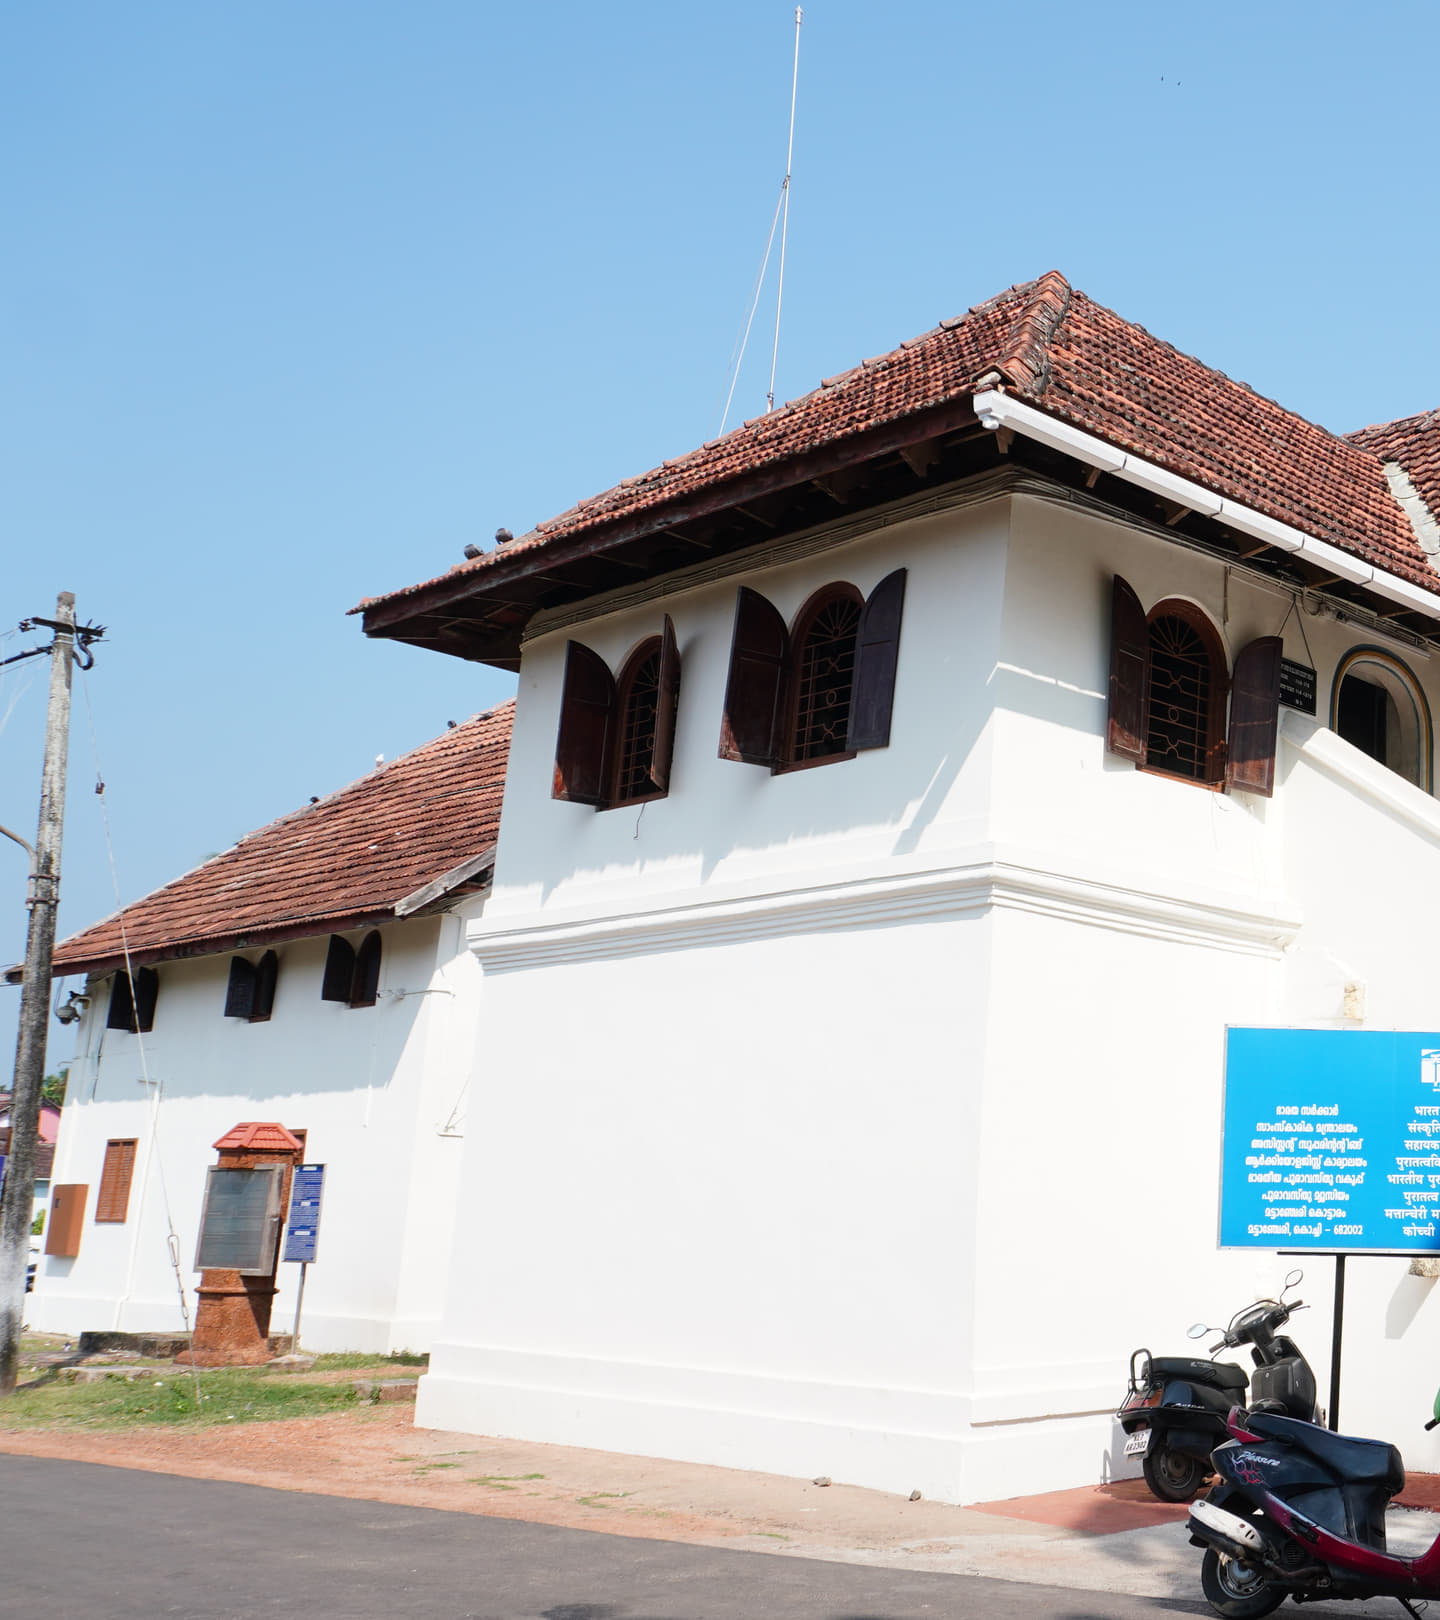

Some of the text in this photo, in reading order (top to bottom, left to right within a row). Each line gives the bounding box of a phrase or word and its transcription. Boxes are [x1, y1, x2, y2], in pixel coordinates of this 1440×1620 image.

[1414, 1106, 1440, 1116] भारत
[1404, 1140, 1440, 1151] सहायक
[1387, 1171, 1424, 1184] भारतीय
[1403, 1191, 1439, 1205] पुरातत्व
[1334, 1225, 1363, 1235] 682002
[1402, 1222, 1436, 1236] कोच्ची
[1236, 1451, 1280, 1466] Pleasure
